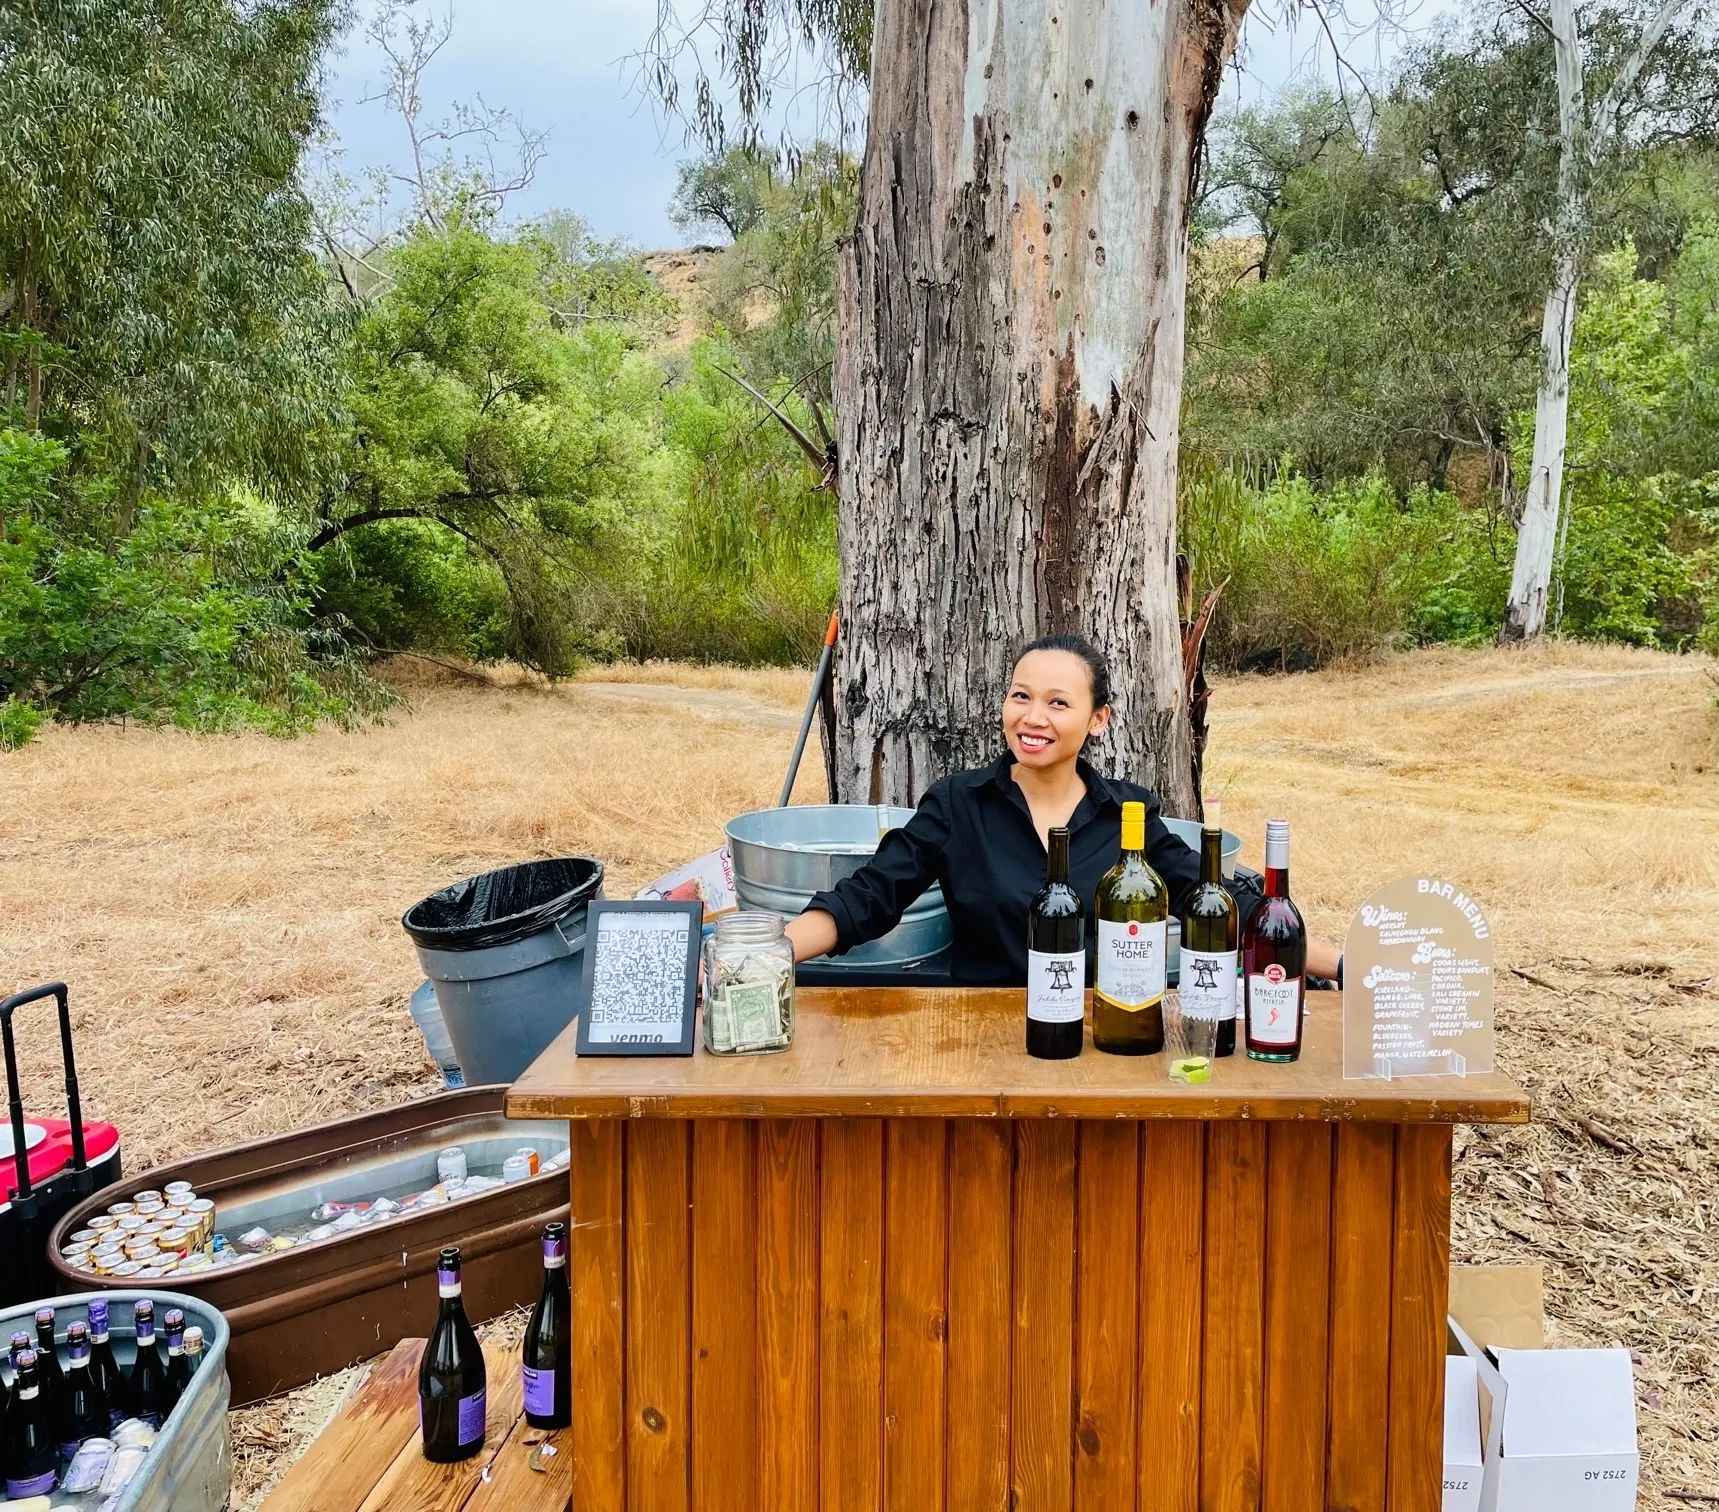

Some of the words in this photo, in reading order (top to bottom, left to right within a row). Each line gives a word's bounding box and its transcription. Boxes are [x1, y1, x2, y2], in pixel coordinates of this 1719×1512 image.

[1417, 879, 1454, 899] BAR
[1453, 892, 1489, 939] MENU
[1360, 904, 1408, 927] Wines:
[1379, 921, 1407, 930] MERLOT
[1420, 927, 1444, 935] BLANC
[1111, 939, 1153, 950] SUTTER
[1116, 950, 1149, 959] HOME
[1432, 959, 1456, 967] COORS
[1254, 987, 1294, 999] BAREFOOT
[1374, 1002, 1397, 1010] BLACK
[1430, 1005, 1453, 1013] STONE
[1428, 1021, 1460, 1029] MODERN
[1460, 1020, 1485, 1029] TIMES
[1432, 1029, 1464, 1037] VARIETY
[610, 1034, 664, 1043] venmo
[1584, 1471, 1600, 1480] AG
[1603, 1470, 1627, 1480] 2752
[1442, 1480, 1469, 1490] 2752
